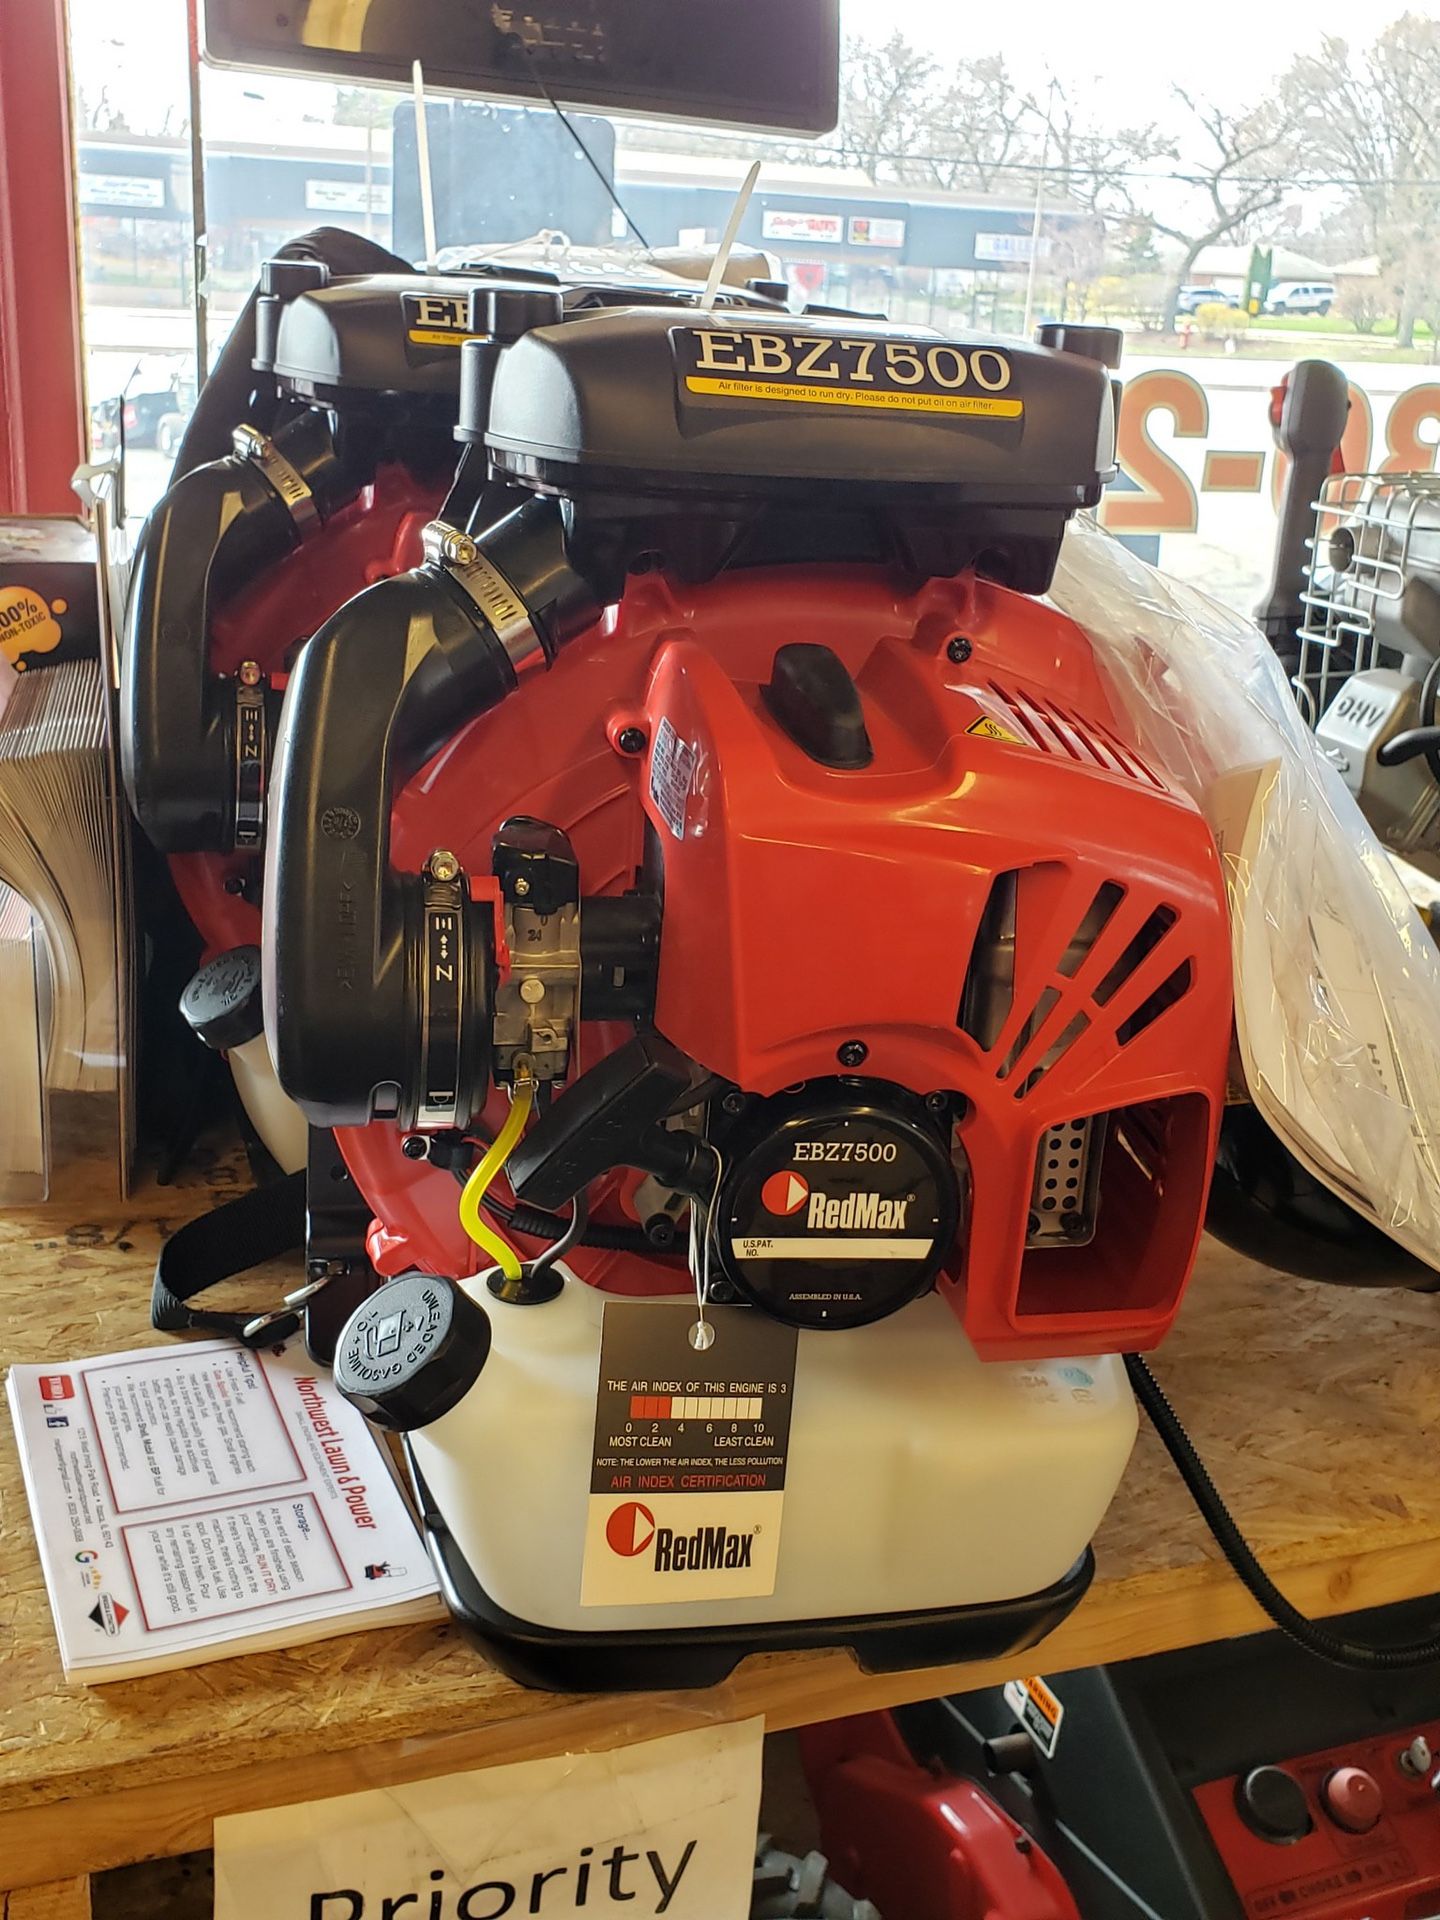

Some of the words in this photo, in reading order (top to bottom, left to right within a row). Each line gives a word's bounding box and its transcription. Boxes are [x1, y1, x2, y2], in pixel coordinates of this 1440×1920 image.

[693, 330, 1011, 392] EBZ7500
[718, 381, 731, 391] Air
[733, 382, 753, 393] filter
[755, 384, 763, 394] is
[765, 385, 806, 398] designed
[808, 388, 817, 398] to
[819, 390, 834, 399] run
[836, 389, 853, 402] dry.
[855, 392, 885, 403] Please
[887, 394, 898, 405] do
[900, 396, 915, 406] not
[917, 397, 932, 408] put
[934, 397, 944, 407] oil
[946, 399, 956, 408] on
[959, 400, 971, 410] air
[0, 598, 37, 632] 00%
[792, 1142, 896, 1162] EBZ7500
[746, 1249, 759, 1257] NO.
[406, 1290, 440, 1363] UNLEADED
[348, 1348, 402, 1381] GASOLINE
[607, 1380, 627, 1391] THE
[631, 1381, 648, 1391] AIR
[652, 1381, 682, 1392] INDEX
[686, 1382, 700, 1392] OF
[704, 1382, 725, 1393] THIS
[729, 1382, 764, 1393] ENGINE
[768, 1383, 777, 1393] IS
[780, 1383, 787, 1394] 3
[625, 1423, 632, 1433] 0
[651, 1423, 659, 1433] 2
[678, 1423, 684, 1433] 4
[706, 1423, 712, 1433] 6
[731, 1423, 738, 1433] 8
[753, 1423, 764, 1433] 10
[609, 1436, 639, 1447] MOST
[639, 1436, 672, 1447] CLEAN
[714, 1436, 744, 1447] LEAST
[745, 1436, 774, 1447] CLEAN
[293, 1375, 340, 1438] Northwest
[320, 1438, 356, 1474] Lawn
[340, 1484, 382, 1531] Power
[596, 1457, 618, 1467] NOTE:
[620, 1457, 634, 1466] THE
[635, 1457, 662, 1466] LOWER
[663, 1457, 676, 1466] THE
[677, 1457, 689, 1466] AIR
[690, 1457, 713, 1467] INDEX,
[714, 1457, 728, 1466] THE
[729, 1457, 746, 1466] LESS
[747, 1456, 783, 1466] POLLUTION
[611, 1476, 632, 1487] AIR
[638, 1475, 674, 1487] INDEX
[681, 1474, 766, 1487] CERTIFICATION
[238, 1513, 251, 1525] your
[255, 1510, 268, 1525] when
[272, 1514, 283, 1525] the
[148, 1529, 161, 1543] your
[164, 1526, 175, 1538] any
[181, 1529, 191, 1538] up
[259, 1526, 271, 1538] you
[276, 1525, 288, 1537] end
[154, 1543, 164, 1554] car
[185, 1538, 197, 1554] while
[265, 1538, 274, 1548] are
[167, 1538, 184, 1568] remaining
[283, 1544, 296, 1559] each
[157, 1554, 169, 1571] while
[232, 1540, 249, 1564] nothing
[243, 1564, 253, 1575] left
[248, 1582, 259, 1593] the
[254, 1553, 268, 1569] RUN
[269, 1548, 286, 1573] finished
[206, 1555, 218, 1570] save
[216, 1585, 228, 1599] Use
[260, 1569, 271, 1577] IT
[289, 1560, 304, 1582] season
[165, 1582, 176, 1593] still
[178, 1569, 191, 1592] season
[224, 1567, 241, 1591] nothing
[234, 1591, 243, 1599] to
[276, 1573, 291, 1590] using
[185, 1592, 197, 1605] fuel
[198, 1583, 212, 1599] Pour
[1023, 1679, 1057, 1719] ARNING
